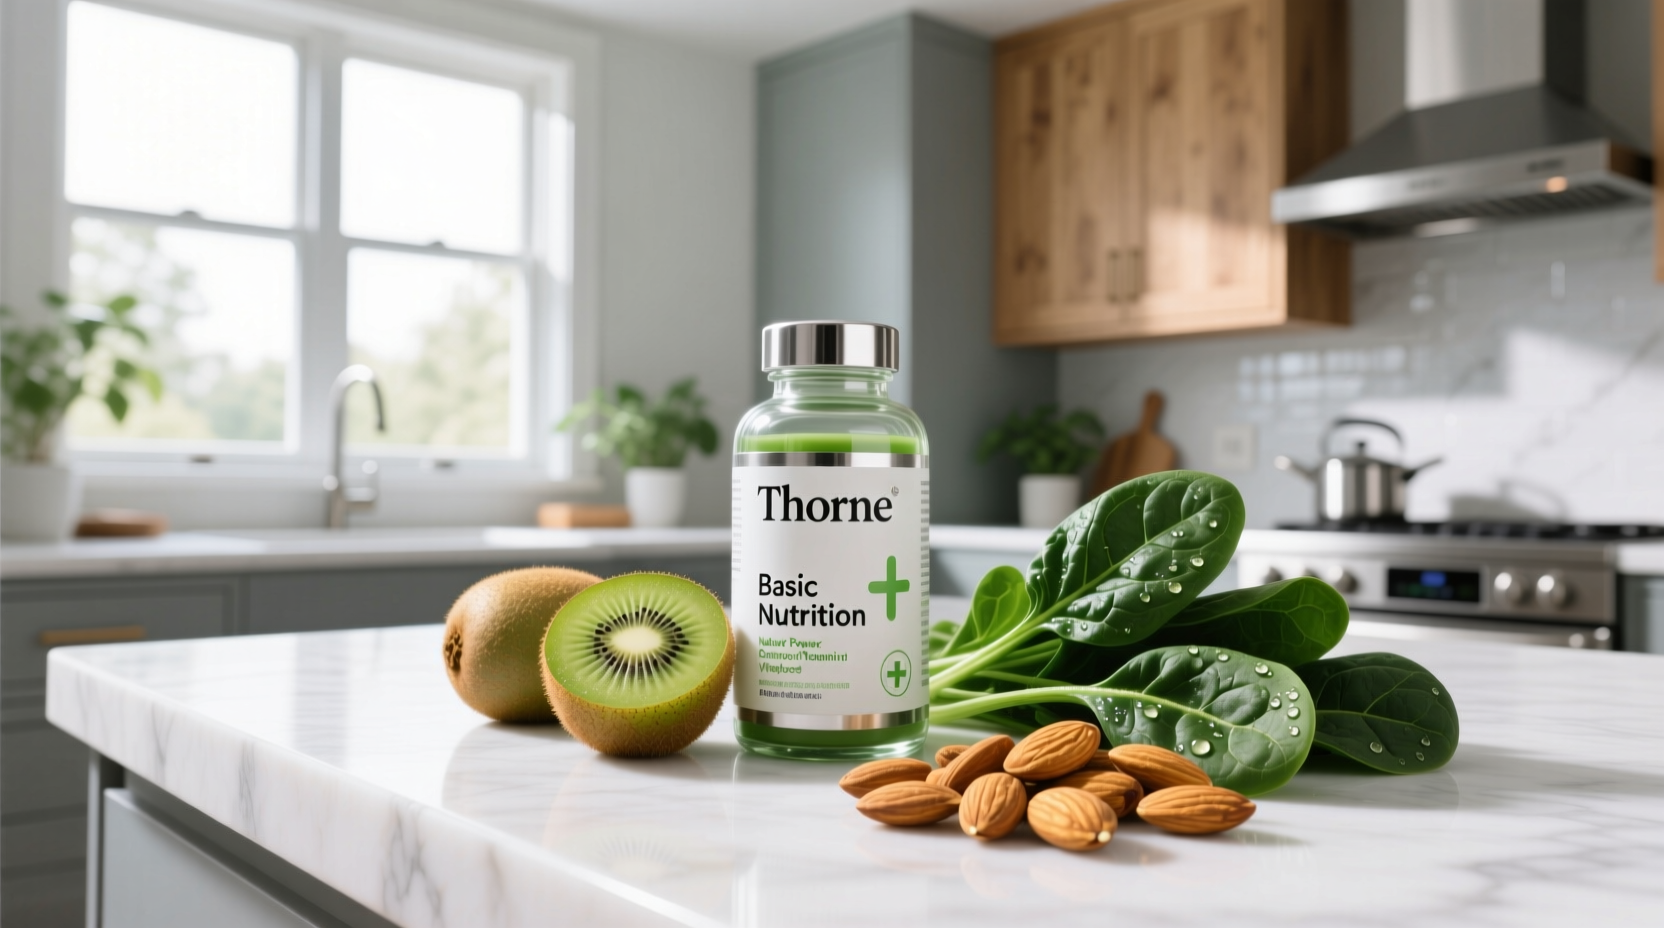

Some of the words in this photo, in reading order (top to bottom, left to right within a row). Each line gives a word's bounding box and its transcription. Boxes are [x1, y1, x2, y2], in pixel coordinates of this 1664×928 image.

[757, 484, 893, 523] Thorne
[759, 573, 818, 597] Basic
[759, 603, 866, 627] Nutrition
